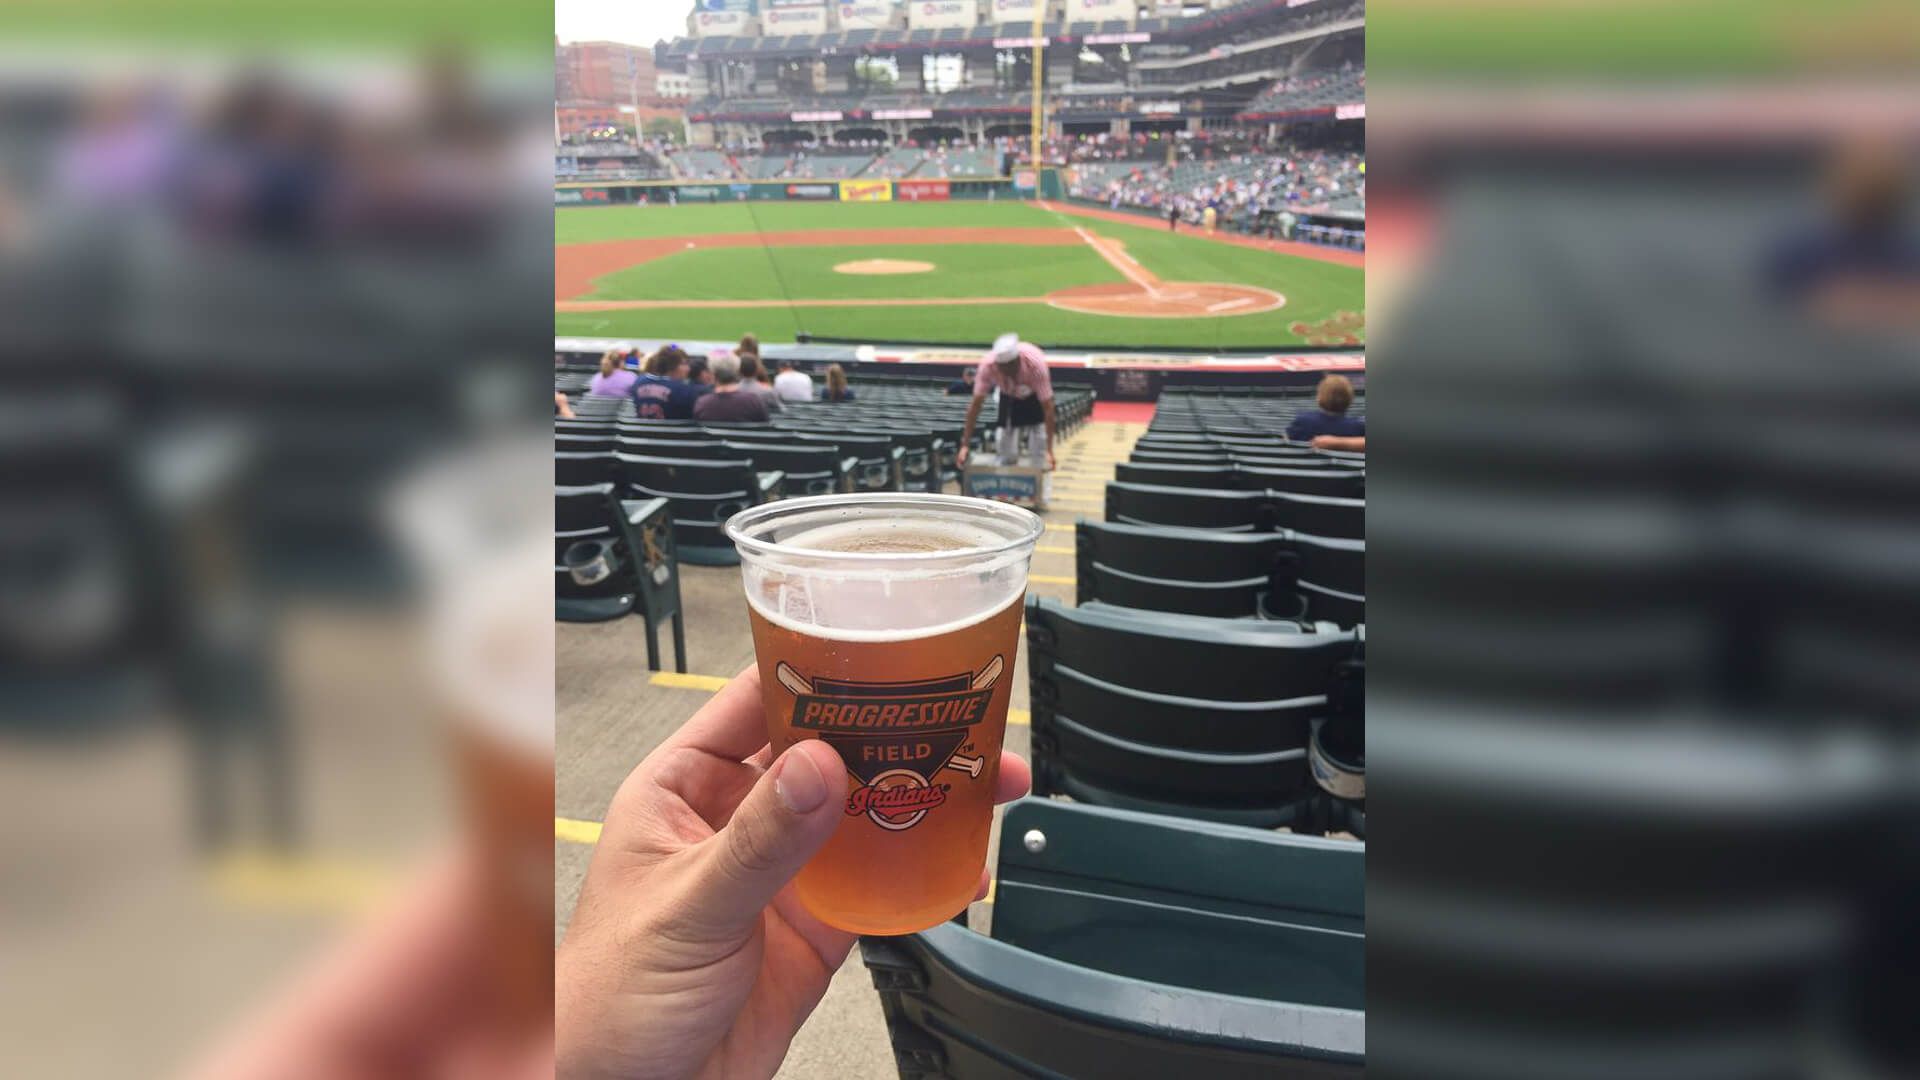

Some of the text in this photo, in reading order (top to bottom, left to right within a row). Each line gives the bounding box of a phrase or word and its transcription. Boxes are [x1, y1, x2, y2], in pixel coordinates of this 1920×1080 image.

[804, 697, 979, 727] PROGRESSIVE
[863, 743, 931, 761] FIELD
[845, 783, 946, 819] Indians
